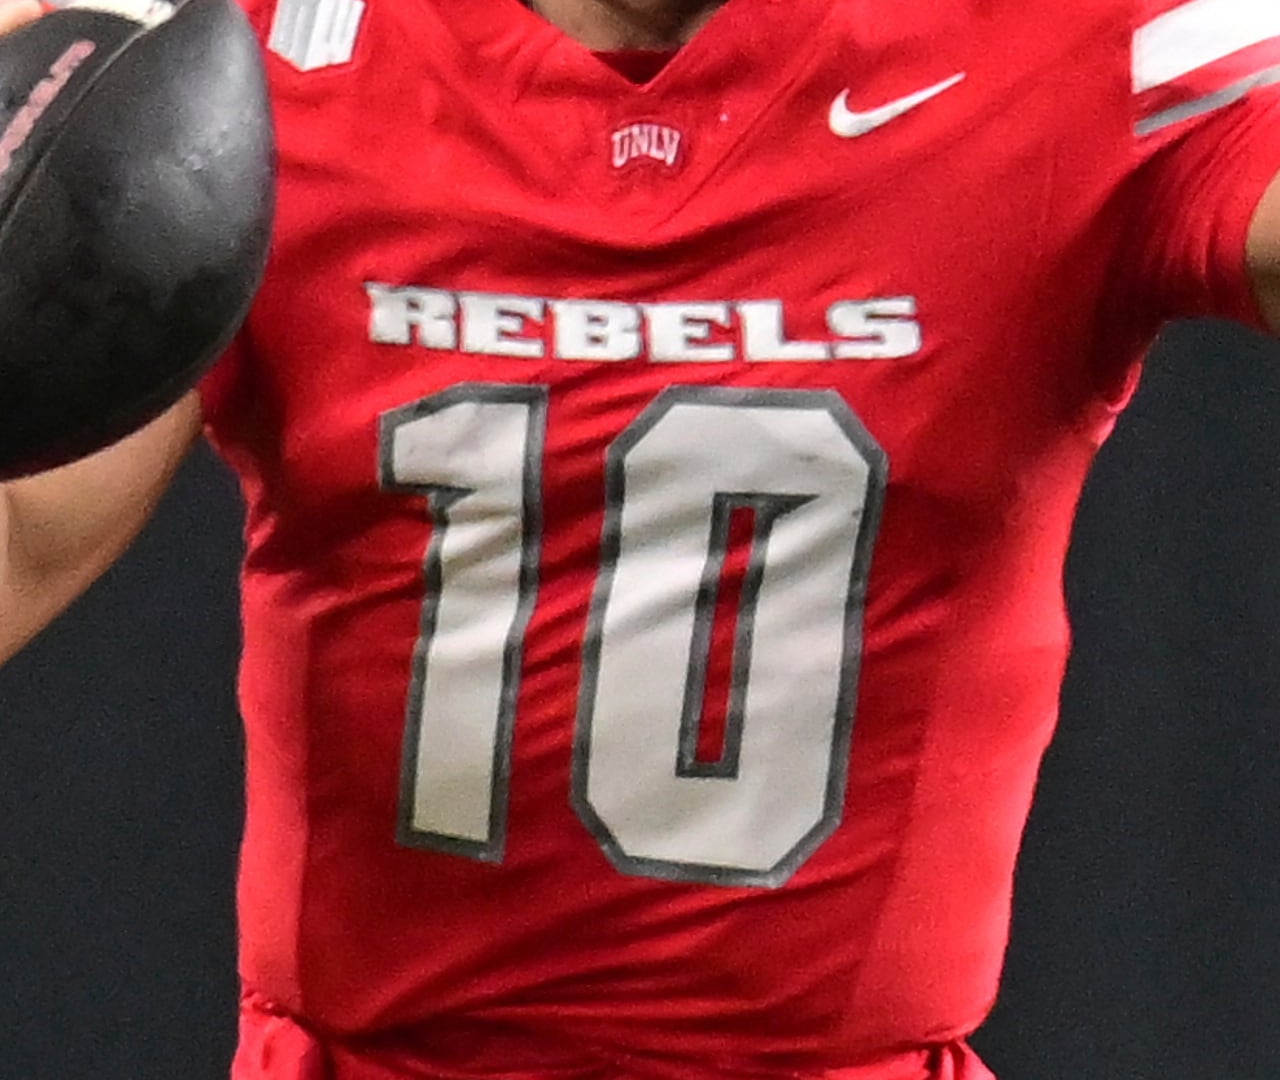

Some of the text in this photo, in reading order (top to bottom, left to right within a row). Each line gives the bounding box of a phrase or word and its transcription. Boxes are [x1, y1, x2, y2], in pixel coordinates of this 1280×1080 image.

[611, 124, 680, 168] UNLV
[363, 281, 922, 362] REBELS
[377, 381, 889, 889] 10
